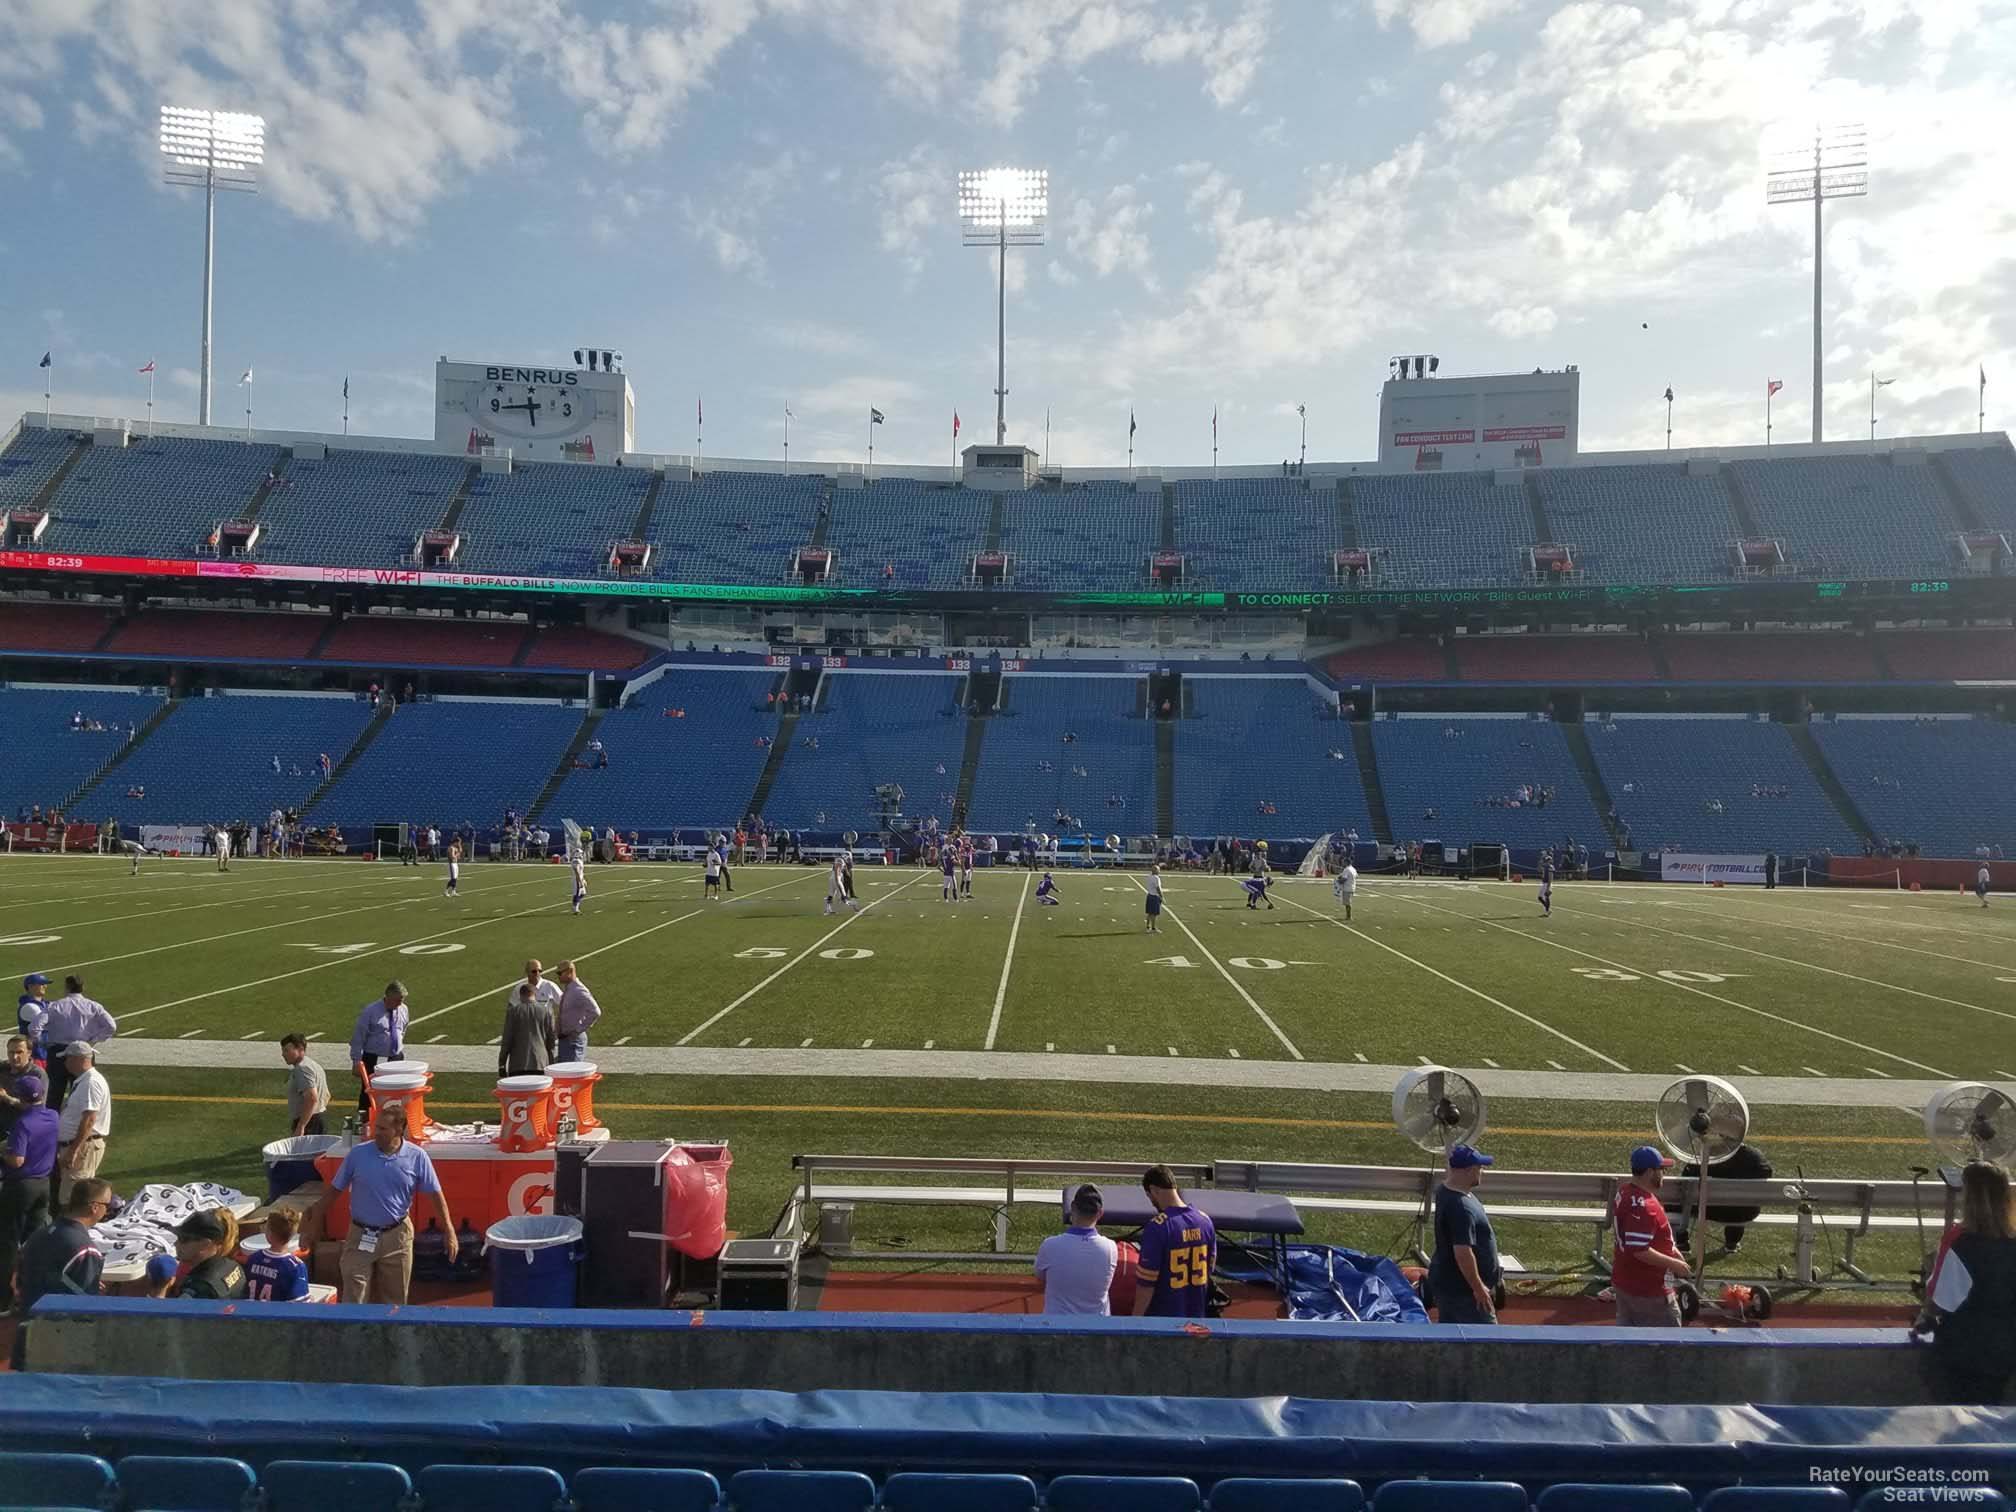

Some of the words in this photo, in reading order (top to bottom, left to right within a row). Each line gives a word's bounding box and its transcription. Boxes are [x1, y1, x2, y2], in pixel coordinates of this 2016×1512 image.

[486, 367, 578, 385] BENRUS
[490, 399, 500, 413] 9
[562, 403, 572, 417] 3
[47, 558, 83, 568] 82:39
[322, 567, 367, 584] FREE
[436, 575, 461, 585] THE
[463, 576, 519, 588] BUFFALO
[522, 579, 555, 589] BILLS
[561, 581, 592, 591] NOW
[595, 583, 645, 593] PROVIDE
[649, 585, 679, 595] BILLS
[683, 586, 713, 596] FANS
[716, 588, 777, 599] ENHANCED
[1911, 582, 1950, 593] 82:39
[1238, 594, 1258, 605] TO
[1262, 593, 1334, 605] CONNECT:
[1338, 594, 1384, 605] SELECT
[1386, 593, 1411, 603] THE
[1415, 592, 1480, 602] NETWORK
[1519, 591, 1553, 601] Guest
[771, 656, 791, 666] 132
[822, 657, 841, 667] 133
[951, 660, 970, 670] 133
[1001, 661, 1020, 671] 134
[554, 1088, 573, 1108] G
[508, 1101, 529, 1123] G
[507, 1172, 555, 1217] G
[1630, 1195, 1646, 1207] 14
[1170, 1245, 1208, 1289] 55
[248, 1280, 273, 1301] 14
